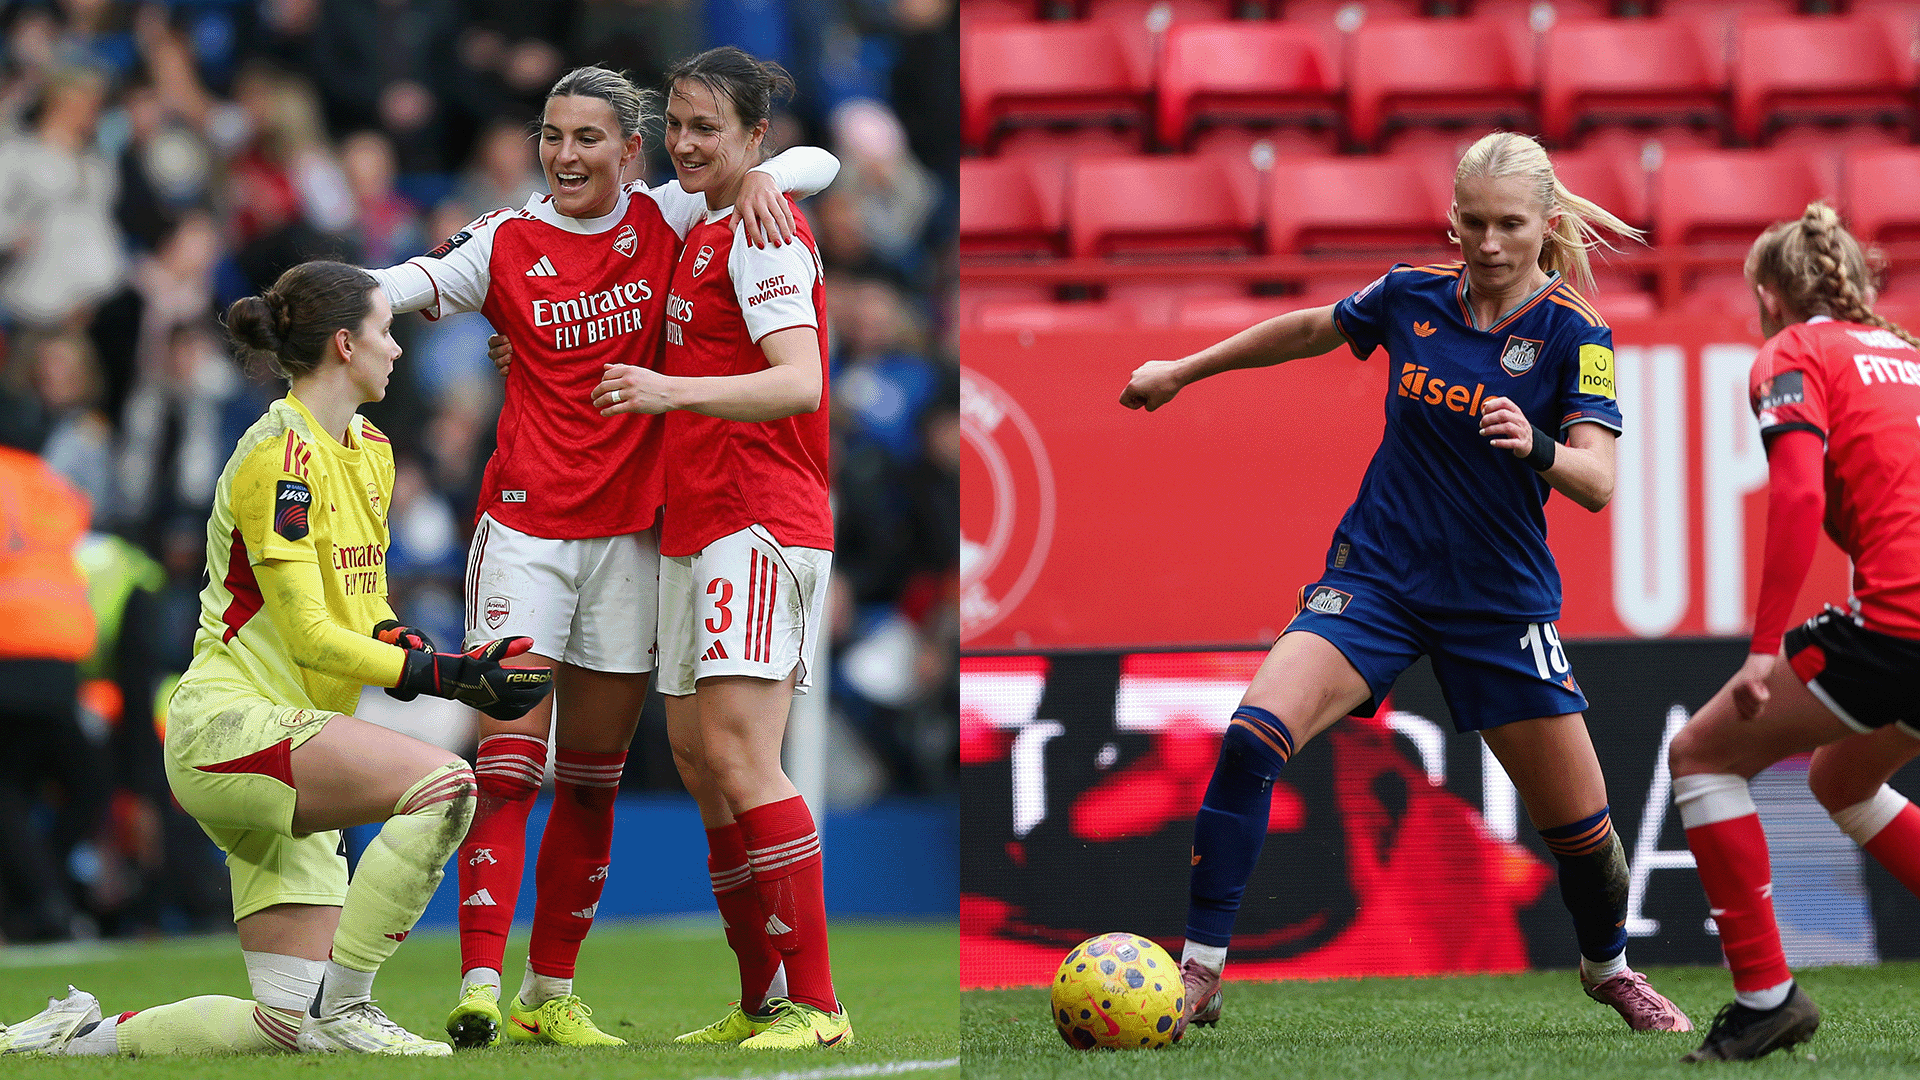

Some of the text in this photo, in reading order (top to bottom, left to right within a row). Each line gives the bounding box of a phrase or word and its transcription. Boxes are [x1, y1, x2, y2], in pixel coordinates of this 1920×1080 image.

[748, 284, 800, 307] RWANDA
[755, 275, 785, 291] VISIT
[531, 279, 653, 327] Emirates
[555, 308, 643, 350] FLY BETTER
[1583, 374, 1613, 391] noon
[1853, 354, 1920, 388] FITZG
[1424, 378, 1499, 417] sel
[279, 489, 310, 503] WSL
[705, 577, 734, 634] 3
[1519, 622, 1569, 680] 18
[506, 667, 552, 683] reusch
